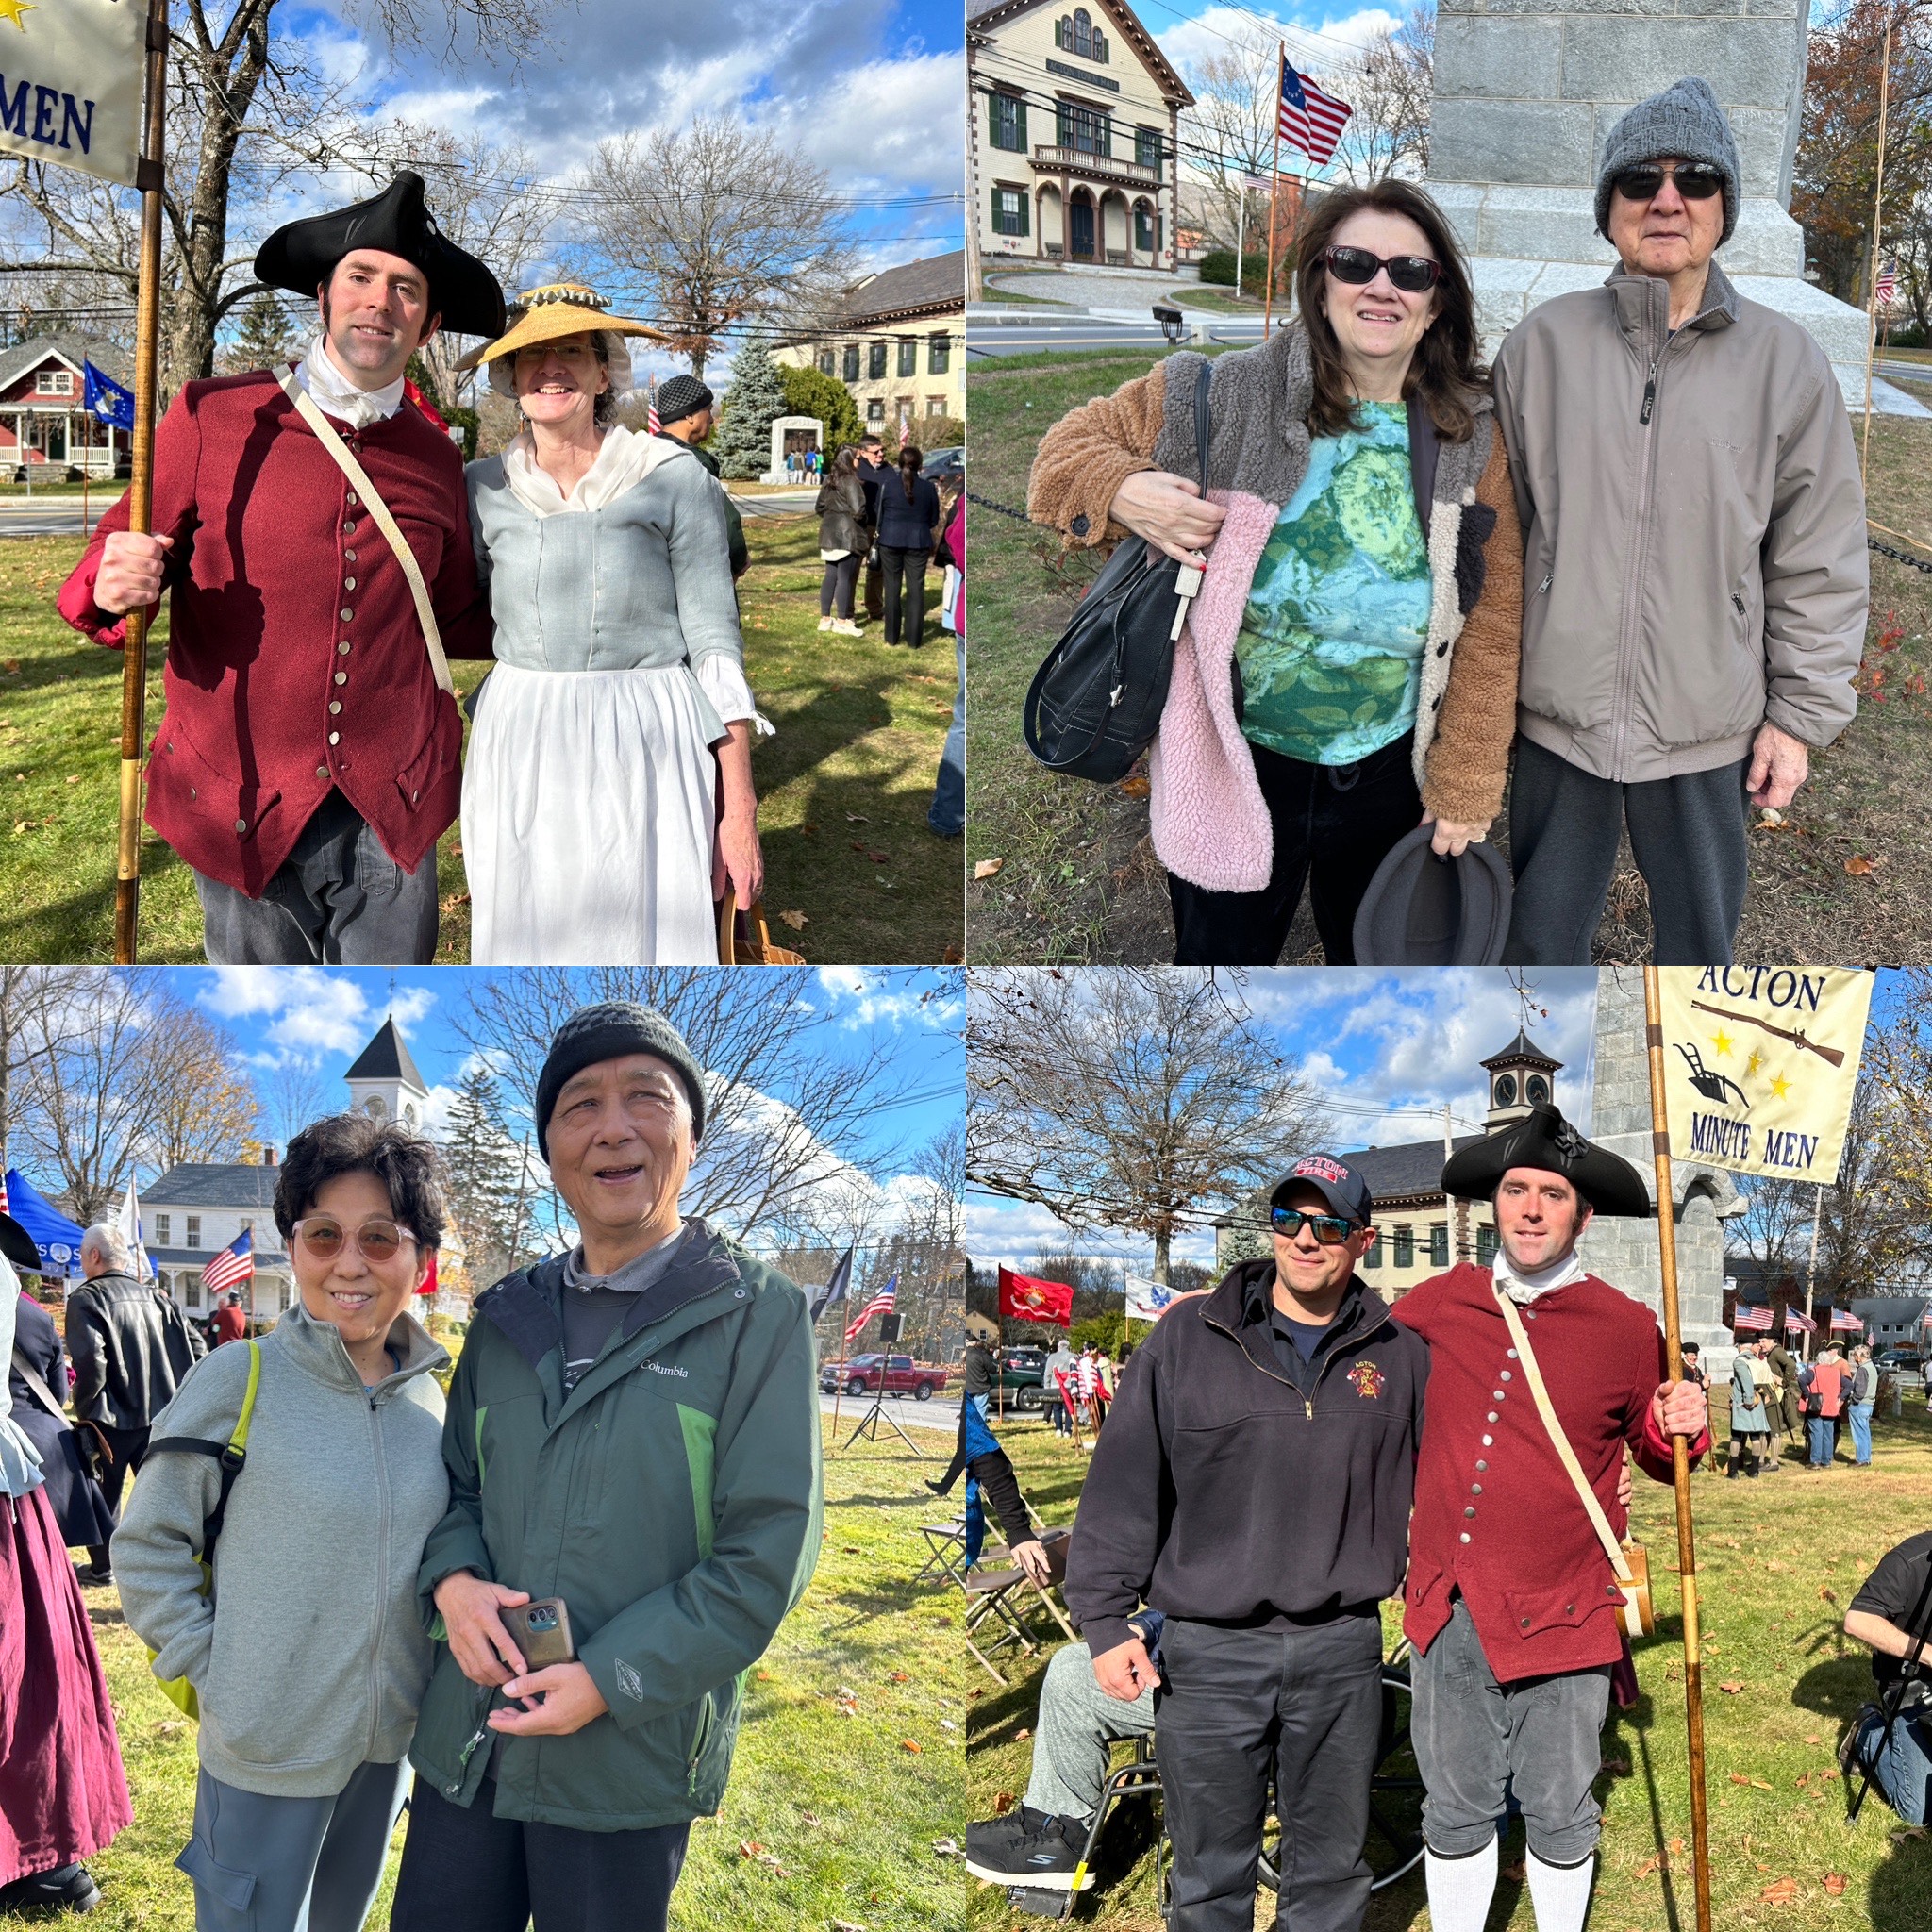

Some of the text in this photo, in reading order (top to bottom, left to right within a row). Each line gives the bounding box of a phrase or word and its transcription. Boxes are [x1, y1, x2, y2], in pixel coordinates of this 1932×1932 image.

[0, 73, 95, 155] MEN
[1697, 966, 1826, 1012] ACTON
[1690, 1111, 1819, 1170] MINUTE MEN
[1291, 1156, 1349, 1180] ACTON
[641, 1359, 689, 1378] Columbia
[1355, 1360, 1377, 1370] ACTON
